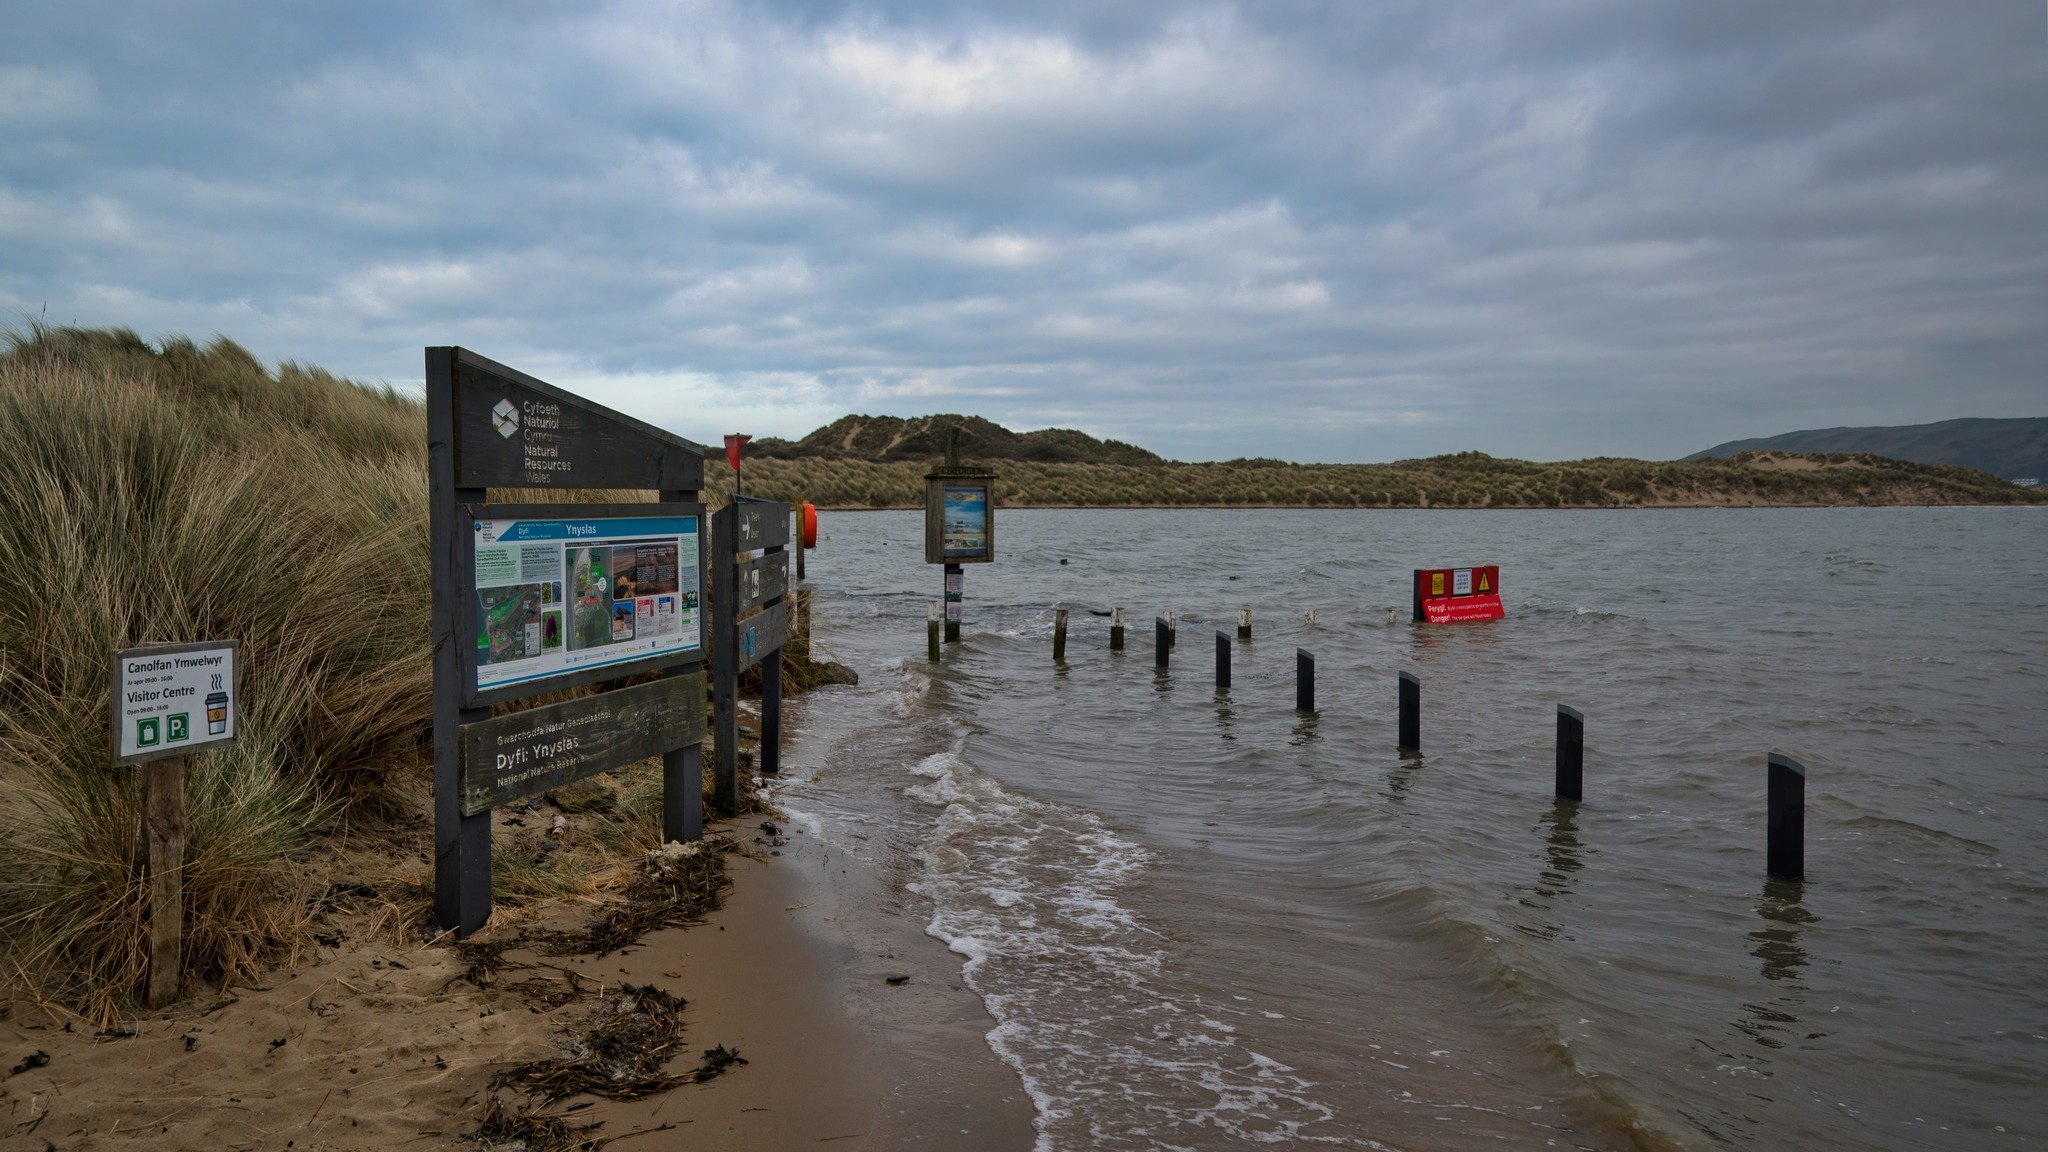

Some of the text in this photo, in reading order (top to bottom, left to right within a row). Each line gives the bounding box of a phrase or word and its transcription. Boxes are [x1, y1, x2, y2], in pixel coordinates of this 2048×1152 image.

[523, 400, 560, 416] Cyfoeth
[523, 415, 560, 430] Naturiol
[524, 429, 552, 442] Cymru
[524, 445, 558, 458] Natural
[524, 458, 572, 472] Resources
[525, 471, 551, 484] Wales
[565, 523, 597, 537] Ynyslas
[1427, 604, 1447, 613] Perygl!
[1430, 613, 1451, 623] Danger!
[128, 655, 223, 674] Canolfan Ymwelwyr
[134, 678, 144, 686] agor
[127, 686, 195, 703] Visitor Centre
[496, 725, 544, 746] Gwarchodfa
[545, 721, 566, 734] Natur
[496, 736, 580, 770] Dyfi: Ynyslas
[497, 769, 530, 788] National
[530, 763, 556, 778] Nature
